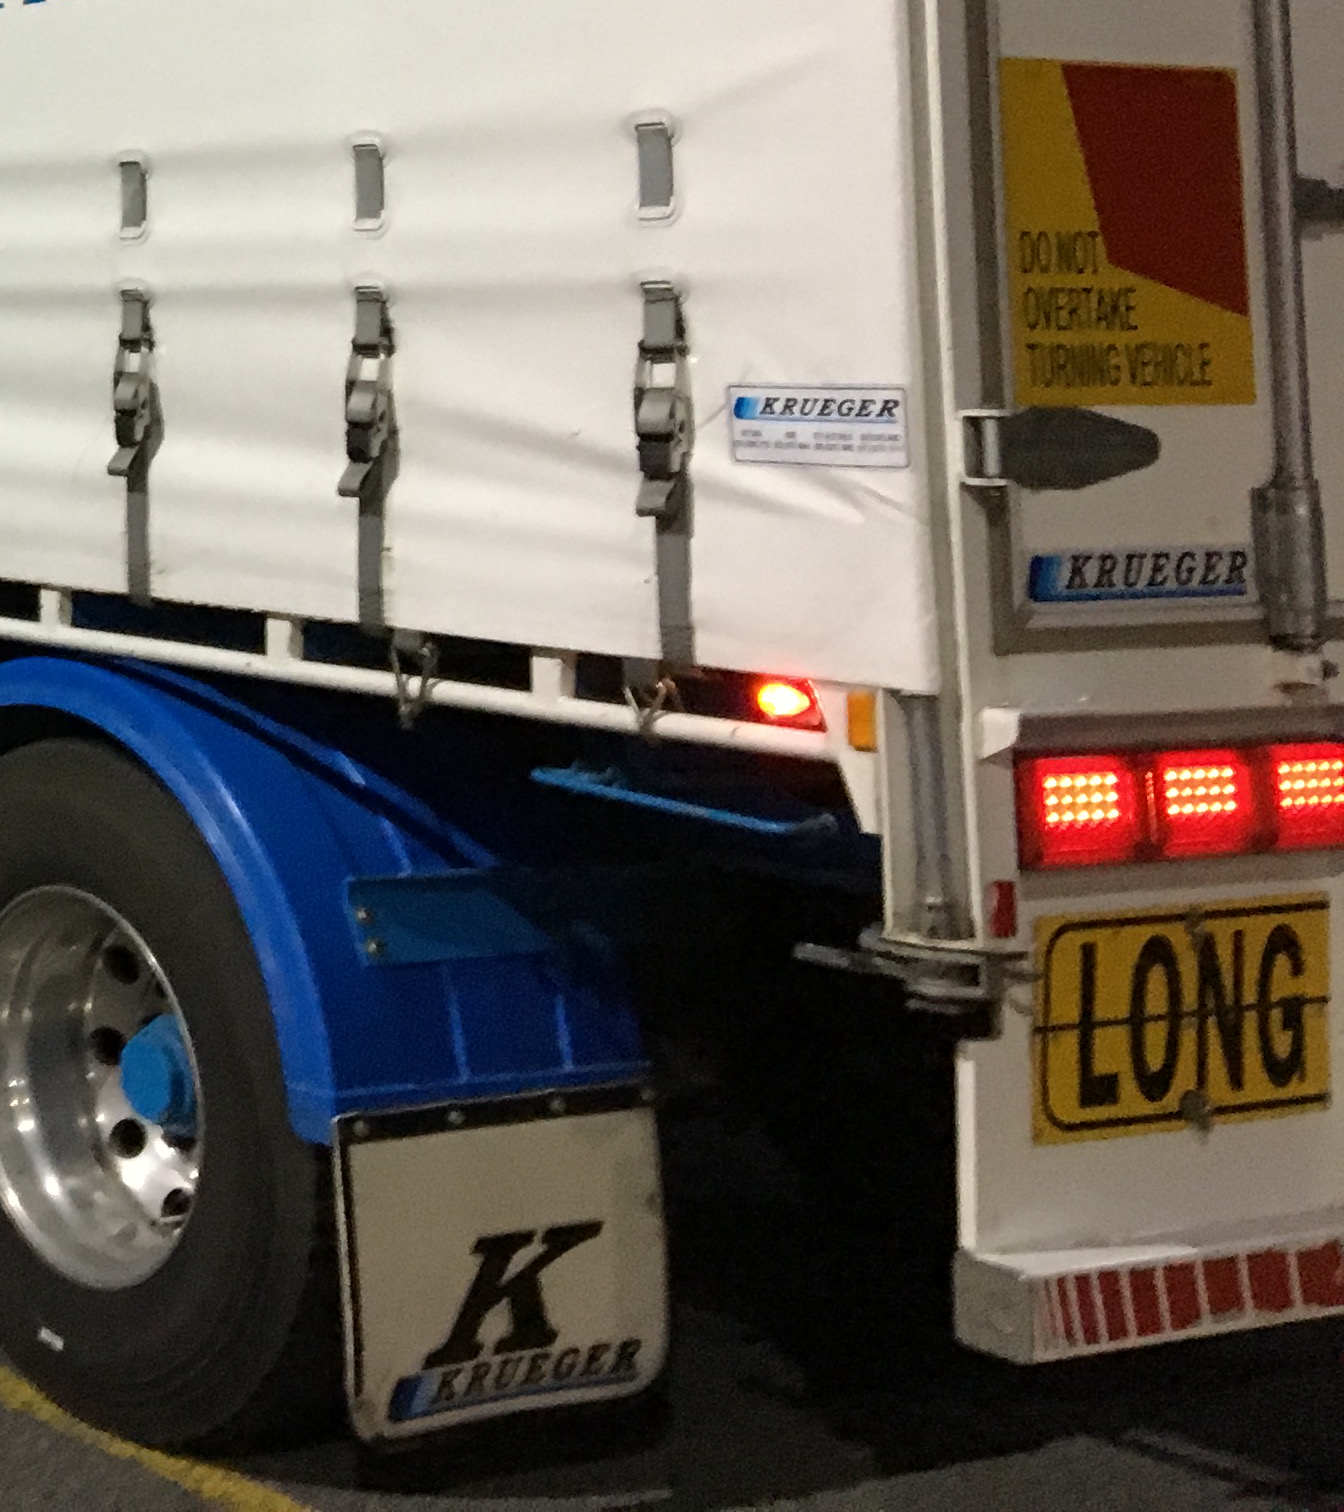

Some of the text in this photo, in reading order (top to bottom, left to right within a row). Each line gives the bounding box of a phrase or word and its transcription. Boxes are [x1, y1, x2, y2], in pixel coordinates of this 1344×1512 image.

[1018, 231, 1101, 274] DO NOT
[1023, 285, 1138, 330] OVERTAKE
[1026, 341, 1212, 387] TURNING VEHICLE
[759, 396, 900, 418] KRUEGER
[1065, 549, 1248, 589] KRUEGER
[1078, 923, 1306, 1109] LONG
[421, 1219, 605, 1371] K
[432, 1338, 642, 1405] KRUEGER
